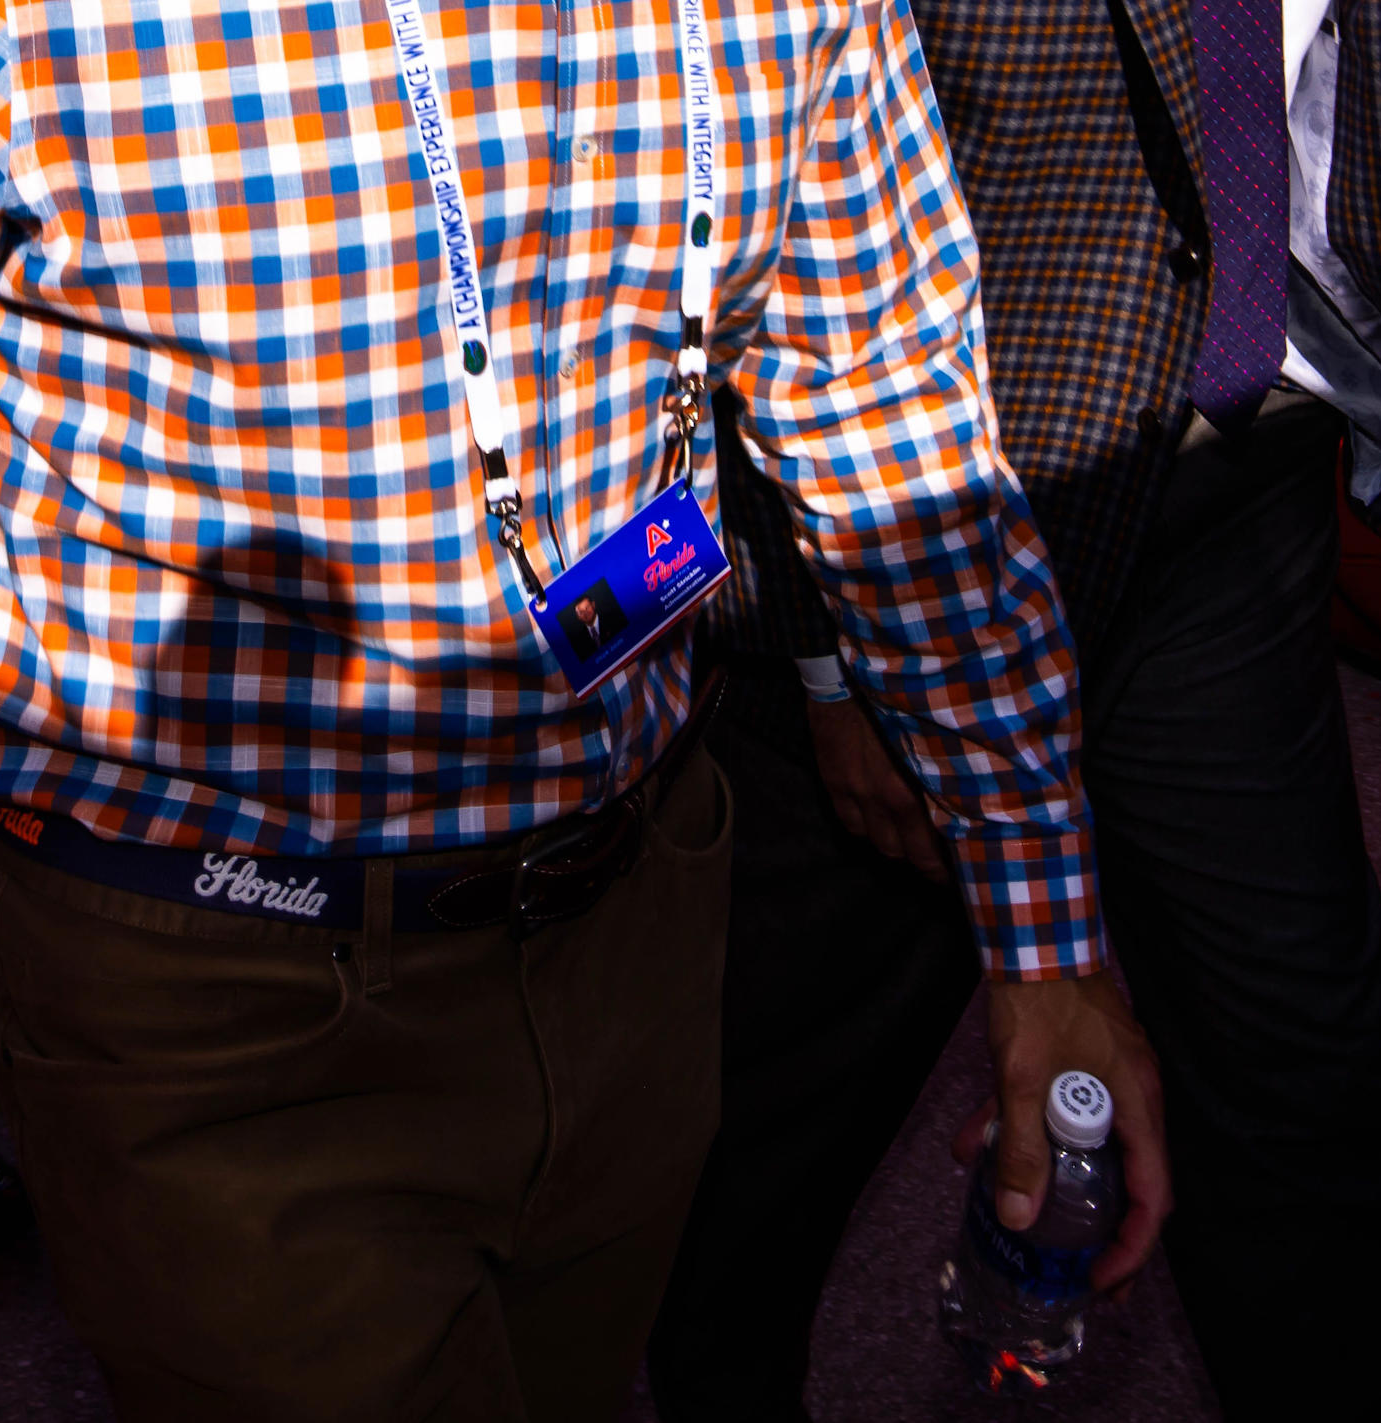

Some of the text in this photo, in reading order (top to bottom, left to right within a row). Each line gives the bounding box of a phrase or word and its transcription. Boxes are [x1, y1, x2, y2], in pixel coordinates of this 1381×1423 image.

[393, 10, 426, 63] WITH
[689, 61, 710, 107] WITH
[406, 63, 452, 175] EXPERIENCE
[692, 112, 713, 201] INTEGRITY
[435, 180, 478, 314] CHAMPIONSHIP
[458, 314, 481, 329] A
[643, 541, 696, 592] Florida
[660, 586, 676, 602] Scott
[194, 852, 329, 918] Florida
